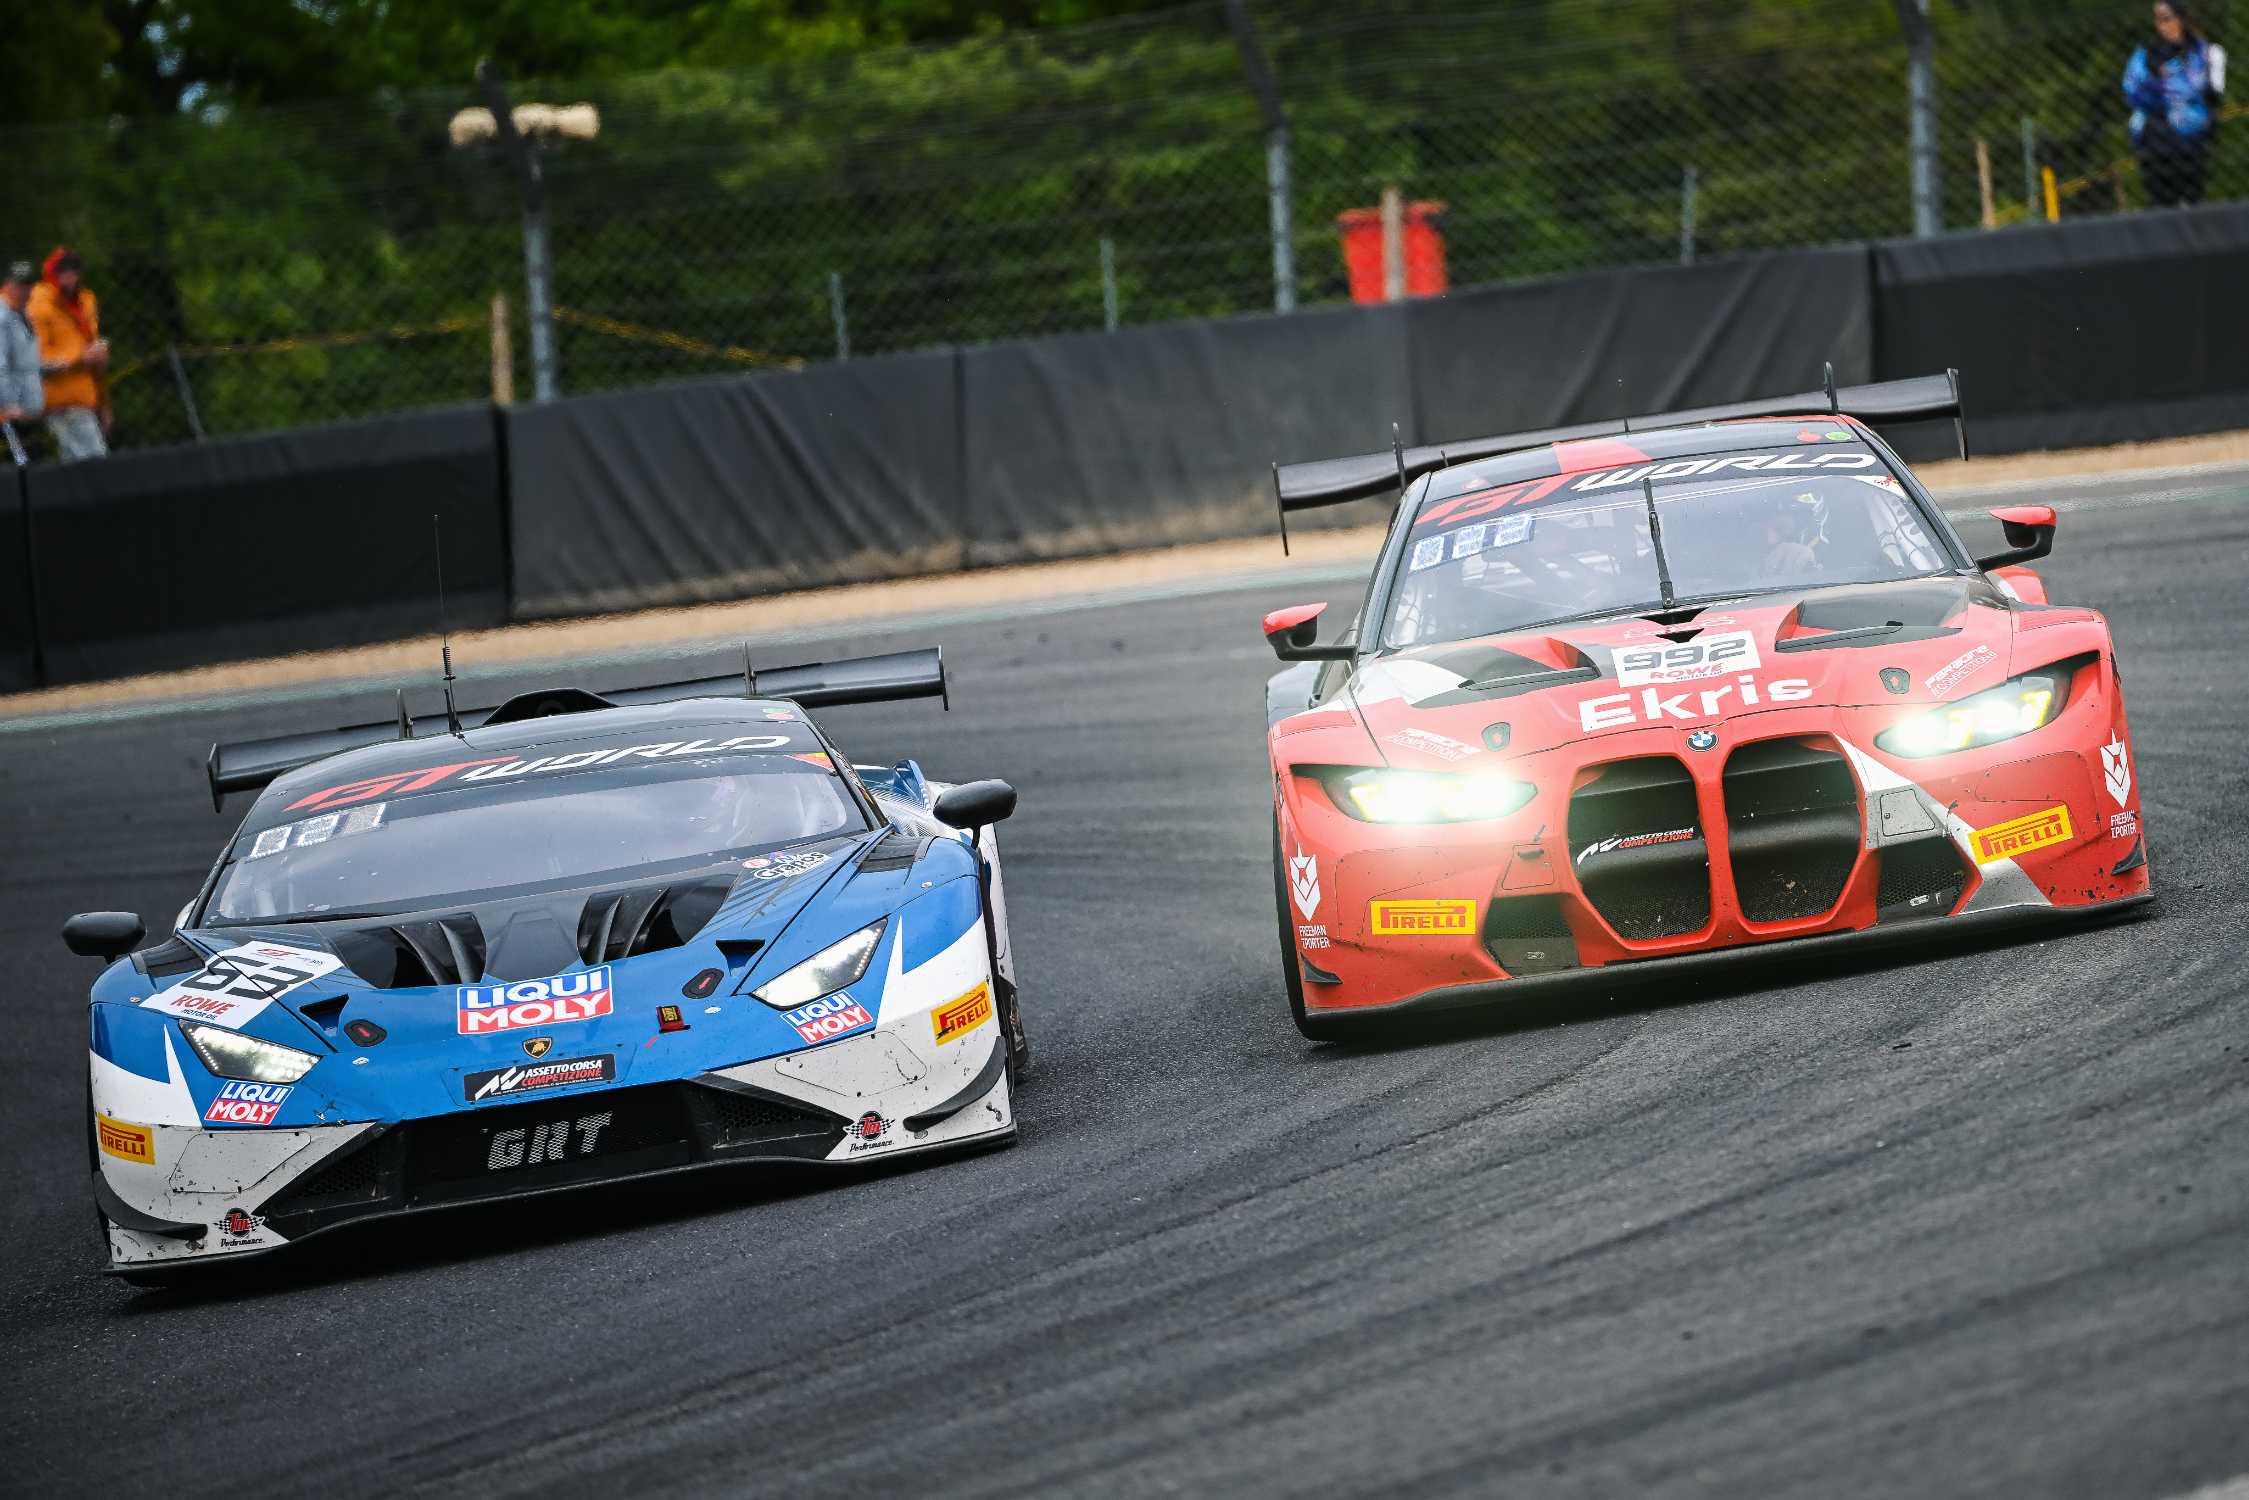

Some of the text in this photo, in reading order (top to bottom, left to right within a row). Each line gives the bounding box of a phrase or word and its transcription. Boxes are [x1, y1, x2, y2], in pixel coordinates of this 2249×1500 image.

[1571, 453, 1877, 492] WORLD
[1623, 638, 1747, 672] 992
[1649, 662, 1724, 680] ROWE
[1578, 674, 1813, 734] Ekris
[458, 735, 791, 781] WORLD
[1617, 831, 1695, 849] COMPETIZIONE
[1621, 830, 1663, 843] ASSETTO
[1979, 813, 2064, 858] PIRELLI
[1380, 906, 1466, 929] PIRELLI
[181, 955, 315, 1000] 63
[466, 970, 602, 1009] LIQUI
[170, 994, 235, 1016] ROWE
[467, 991, 606, 1032] MOLY
[786, 992, 855, 1027] LIQUI
[938, 990, 989, 1034] PIRELLI
[800, 1006, 866, 1042] MOLY
[521, 1067, 604, 1088] COMPETIZIONE
[525, 1058, 603, 1078] ASSETTO CORSA
[220, 1082, 289, 1104] LIQUI
[208, 1100, 279, 1122] MOLY
[99, 1121, 146, 1157] PIRELLI
[487, 1110, 613, 1170] GRT
